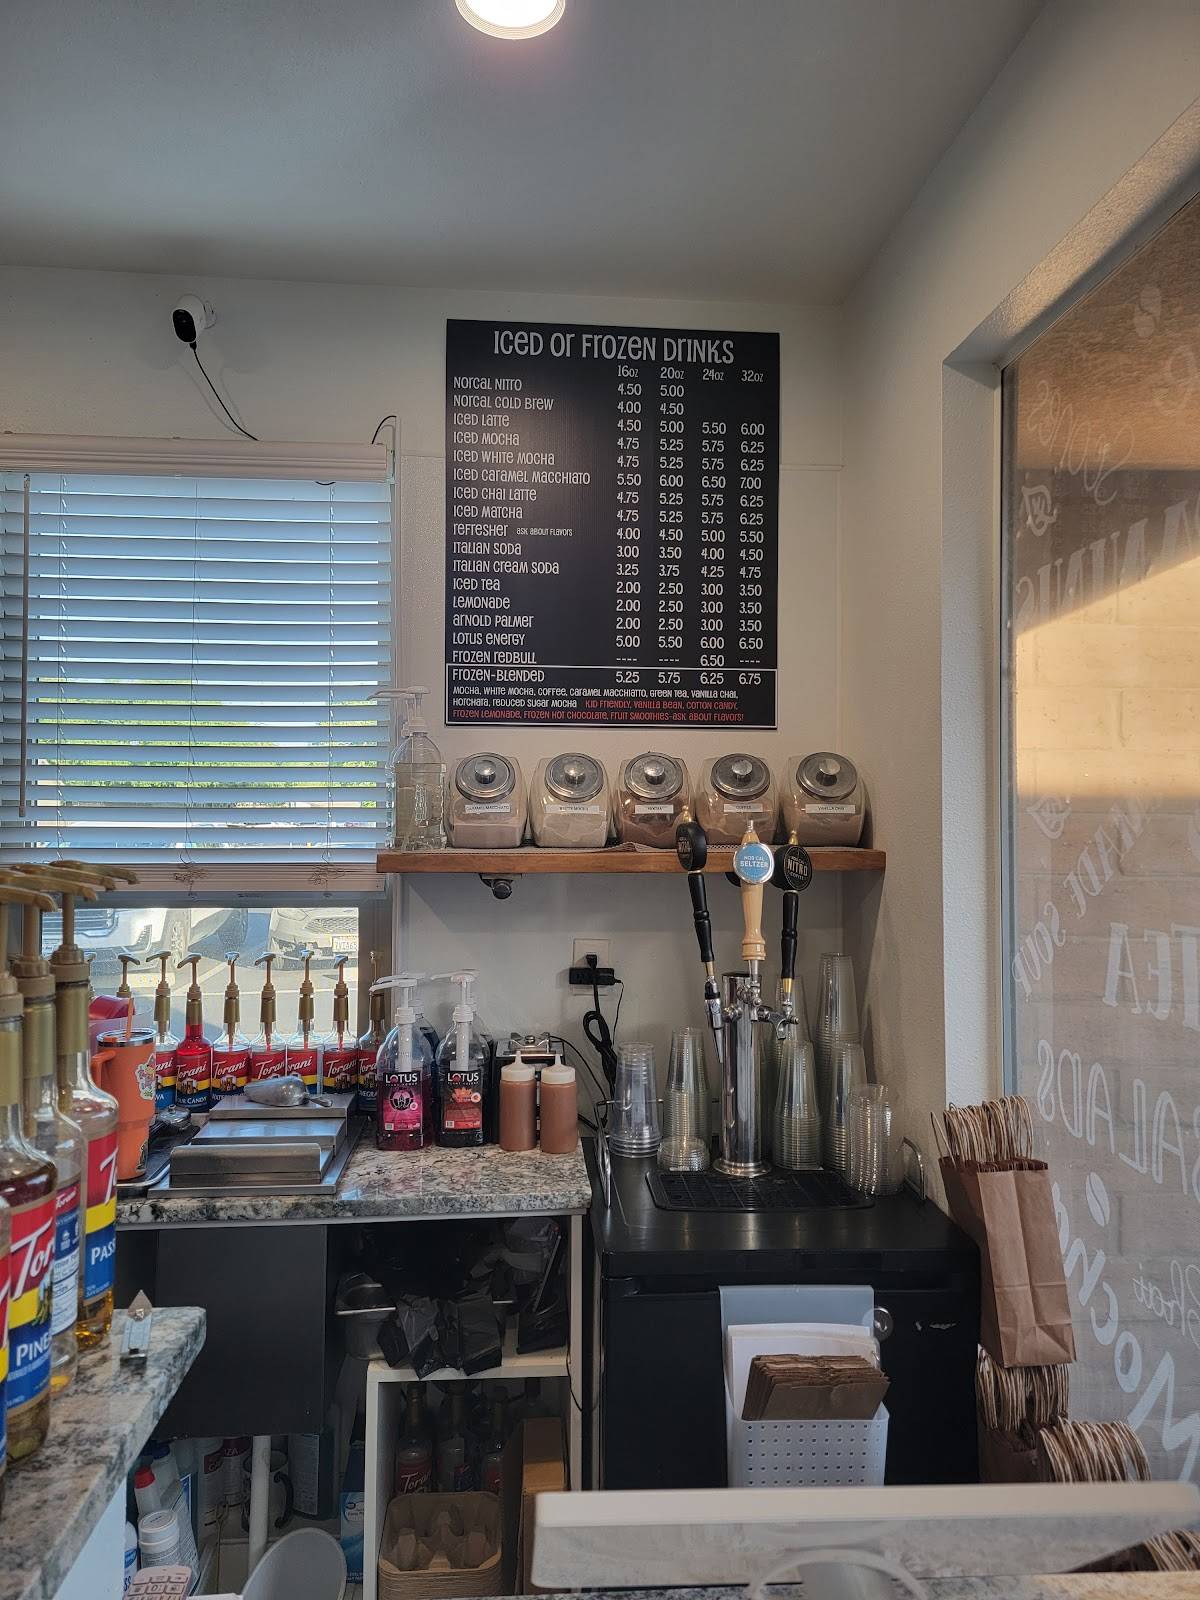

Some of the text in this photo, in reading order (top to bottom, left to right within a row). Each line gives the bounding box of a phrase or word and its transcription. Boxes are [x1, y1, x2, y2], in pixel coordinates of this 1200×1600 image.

[494, 330, 734, 363] ICED OR FROZEN DRINKS
[617, 364, 763, 382] 16oz 20oz 24oz 32oz
[617, 383, 641, 395] 4.50
[660, 384, 684, 397] 5.00
[617, 400, 641, 413] 4.00
[659, 402, 684, 415] 4.50
[617, 418, 641, 431] 4.50
[659, 420, 684, 433] 5.00
[702, 421, 726, 434] 5.50
[740, 422, 764, 435] 6.00
[616, 437, 639, 449] 4.75
[659, 438, 683, 451] 5.25
[702, 440, 724, 452] 5.75
[740, 440, 764, 453] 6.25
[616, 455, 639, 467] 4.75
[659, 456, 683, 469] 5.25
[701, 457, 724, 470] 5.75
[740, 458, 764, 471] 6.25
[616, 473, 641, 486] 5.50
[659, 474, 683, 487] 6.00
[701, 475, 726, 488] 6.50
[740, 477, 761, 489] 7.00
[616, 491, 639, 503] 4.75
[659, 492, 683, 505] 5.25
[701, 493, 723, 506] 5.75
[739, 494, 763, 507] 6.25
[616, 509, 639, 521] 4.75
[659, 510, 683, 522] 5.25
[701, 512, 723, 524] 5.75
[739, 512, 763, 525] 6.25
[616, 527, 640, 539] 4.00
[658, 528, 683, 541] 4.50
[701, 529, 725, 542] 5.00
[739, 530, 764, 543] 5.50
[616, 545, 639, 557] 3.00
[658, 546, 681, 559] 3.50
[700, 547, 724, 560] 4.00
[739, 548, 763, 560] 4.50
[616, 563, 639, 575] 3.25
[658, 564, 679, 576] 3.75
[700, 565, 724, 577] 4.25
[739, 566, 761, 578] 4.75
[616, 581, 641, 593] 2.00
[658, 582, 683, 594] 2.50
[700, 583, 723, 595] 3.00
[739, 584, 762, 596] 3.50
[616, 599, 640, 611] 2.00
[658, 600, 683, 612] 2.50
[700, 601, 723, 613] 3.00
[739, 601, 762, 614] 3.50
[616, 617, 640, 629] 2.00
[658, 617, 683, 630] 2.50
[700, 618, 723, 631] 3.00
[739, 619, 762, 631] 3.50
[615, 635, 640, 647] 5.00
[658, 635, 682, 648] 5.50
[700, 636, 724, 649] 6.00
[738, 637, 763, 649] 6.50
[700, 654, 724, 666] 6.50
[615, 671, 639, 683] 5.25
[658, 671, 680, 683] 5.75
[700, 672, 724, 684] 6.25
[738, 672, 761, 685] 6.75
[740, 860, 769, 868] SELTZER
[787, 858, 808, 877] NITRO
[176, 1061, 207, 1079] Torani
[213, 1057, 247, 1079] Torani
[256, 1059, 285, 1080] Toran
[385, 1072, 418, 1084] LOTUS
[447, 1072, 480, 1083] LOTUS
